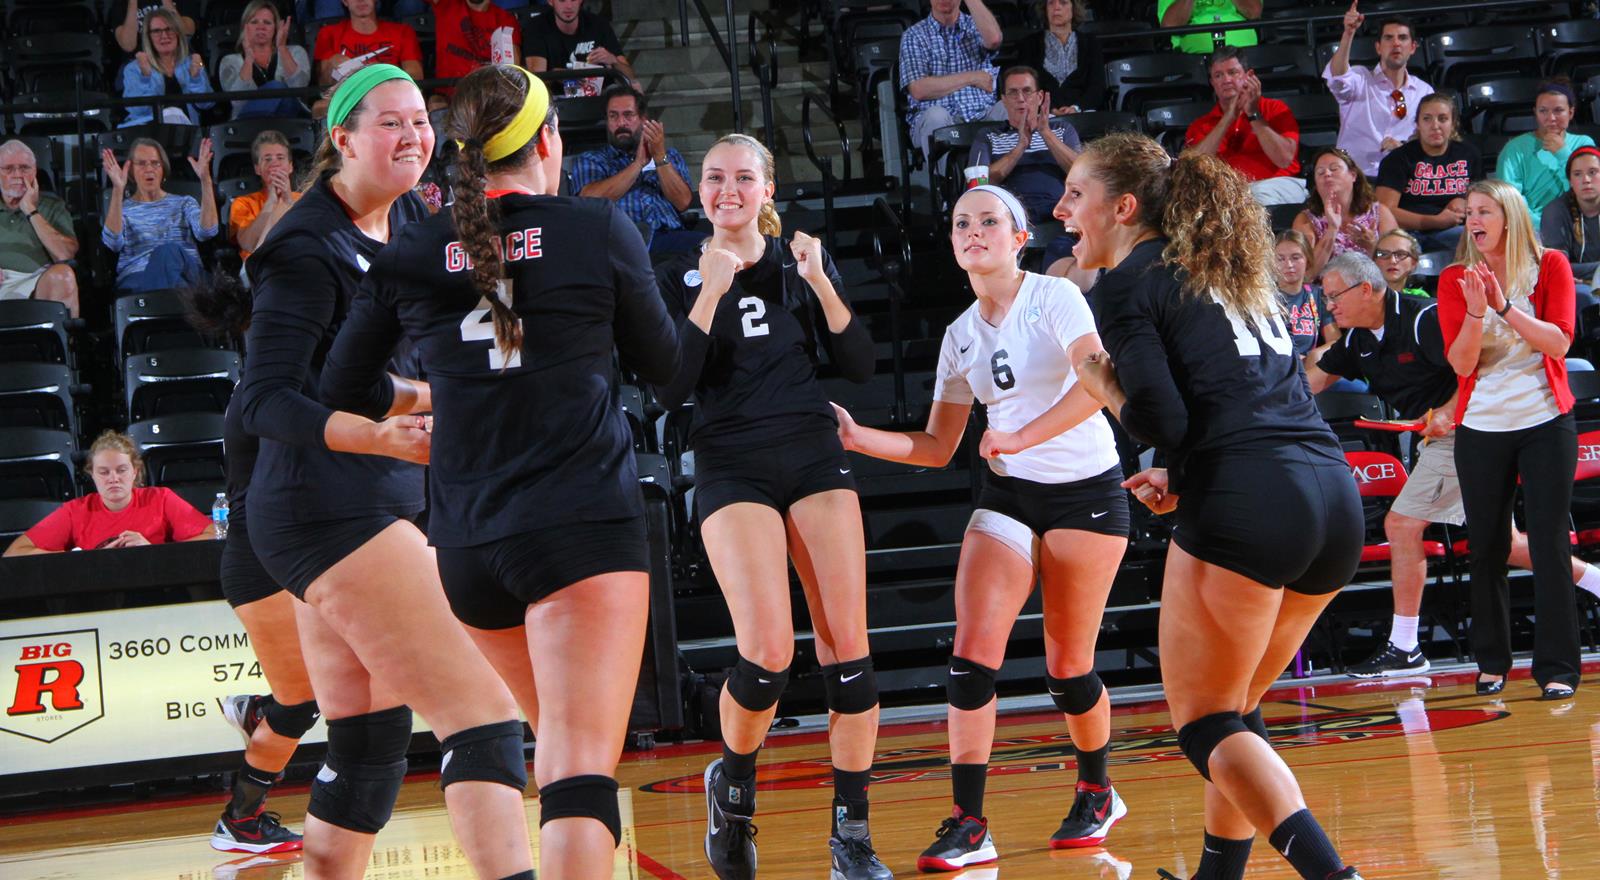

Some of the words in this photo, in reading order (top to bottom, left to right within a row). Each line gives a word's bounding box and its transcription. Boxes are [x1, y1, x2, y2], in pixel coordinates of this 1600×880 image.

[950, 130, 960, 138] 12
[1415, 160, 1468, 179] GRACE
[445, 227, 544, 273] GACE
[138, 299, 145, 307] 5
[460, 278, 523, 370] 4
[738, 296, 770, 338] 2
[1210, 286, 1294, 357] 10
[151, 358, 158, 366] 5
[991, 349, 1015, 390] 6
[1353, 463, 1396, 483] ACE
[20, 642, 72, 660] BIG
[109, 637, 171, 660] 3660
[180, 632, 249, 652] COMM
[213, 660, 263, 682] 574
[7, 659, 84, 716] R
[166, 702, 207, 720] BIG
